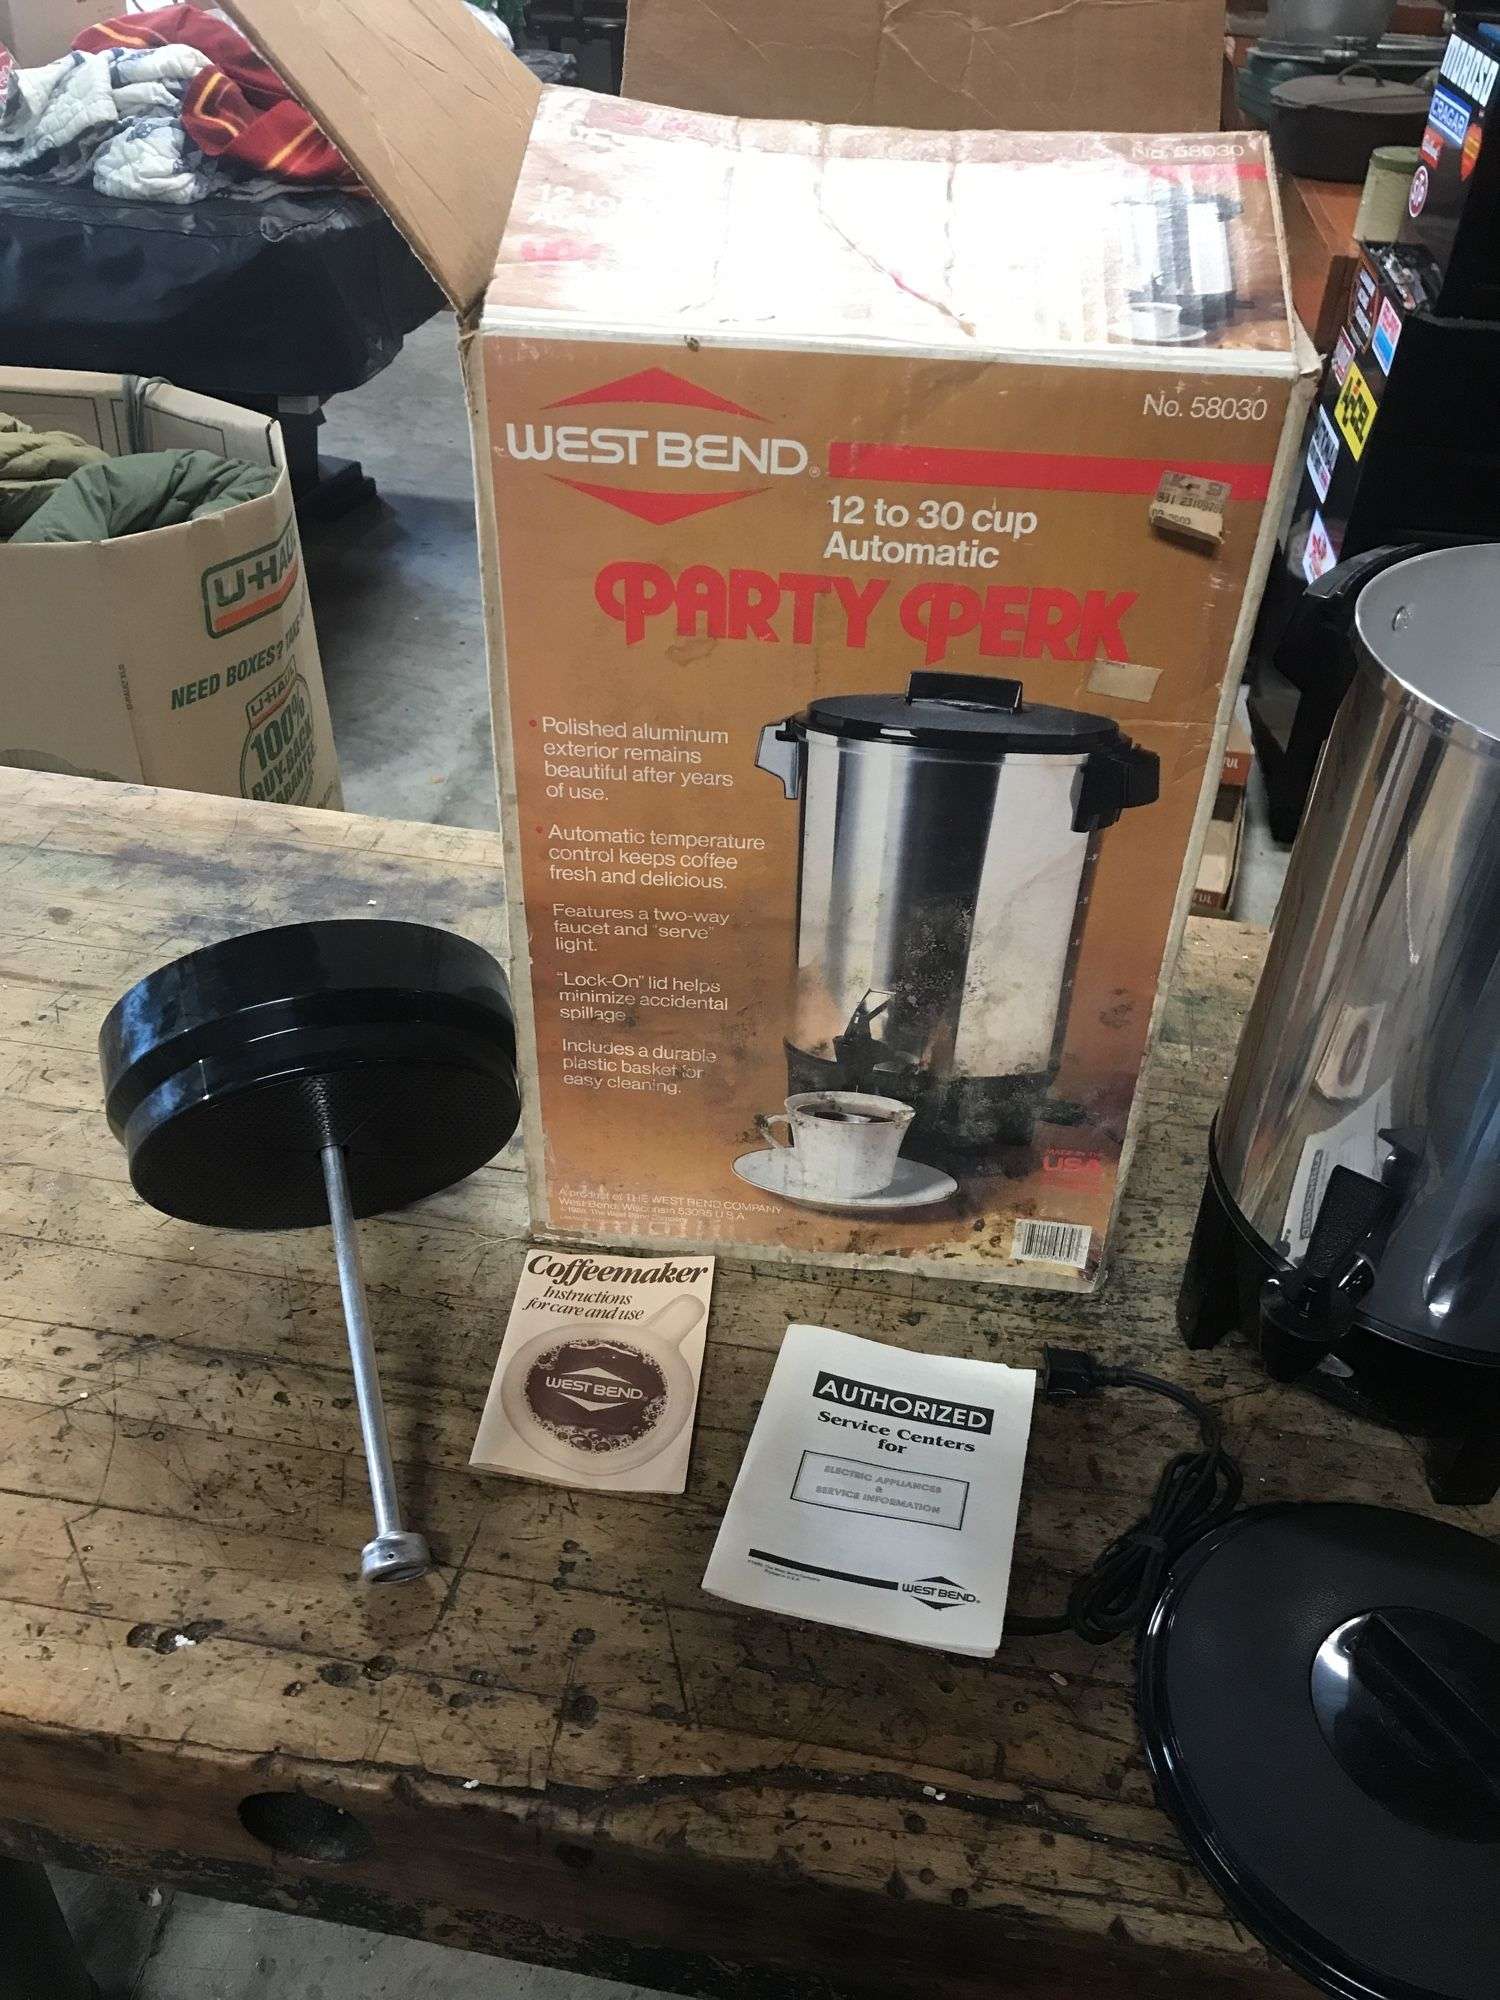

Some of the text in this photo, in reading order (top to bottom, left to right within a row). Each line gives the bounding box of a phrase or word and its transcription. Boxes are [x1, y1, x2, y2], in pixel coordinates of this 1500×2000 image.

[1143, 393, 1268, 421] No. 58030
[506, 423, 808, 476] WEST BEND
[829, 495, 1038, 540] 12 to 30 cup
[824, 531, 1000, 569] Automatic
[594, 561, 1140, 666] PARTY PERK
[171, 672, 220, 710] NEED
[227, 640, 283, 687] BOXES?
[251, 691, 305, 770] 100%
[542, 716, 728, 744] Polished aluminum
[252, 714, 312, 800] BUY-BACK
[544, 742, 702, 764] exterior remains
[544, 761, 734, 787] beautiful after years
[546, 783, 609, 801] of use.
[548, 824, 765, 850] Automatic temperature
[549, 846, 738, 869] control keeps coffee
[550, 865, 727, 889] fresh and delicious.
[553, 903, 729, 926] Features a two-way
[554, 920, 610, 935] faucet
[614, 921, 648, 937] and
[555, 937, 597, 954] light.
[648, 976, 668, 991] lid
[672, 979, 721, 994] helps
[559, 990, 728, 1011] minimize accidental
[562, 1038, 716, 1064] Includes a durable
[563, 1056, 617, 1073] plastic
[621, 1059, 677, 1077] basket
[563, 1074, 682, 1095] easy cleaning.
[652, 1194, 685, 1206] WEST
[687, 1198, 721, 1209] BEND
[723, 1201, 784, 1214] COMPANY
[527, 1254, 709, 1286] Coffeemaker
[543, 1285, 634, 1305] Instructions
[522, 1297, 645, 1321] for care and use
[545, 1376, 644, 1400] WEST BEND
[818, 1379, 987, 1429] AUTHORIZED
[817, 1410, 976, 1453] Service Centers
[877, 1438, 908, 1454] for
[824, 1465, 942, 1494] ELECTRIC APPLIANCES
[815, 1485, 941, 1514] SERVICE INFORMATION
[902, 1583, 976, 1603] WEST BEND
